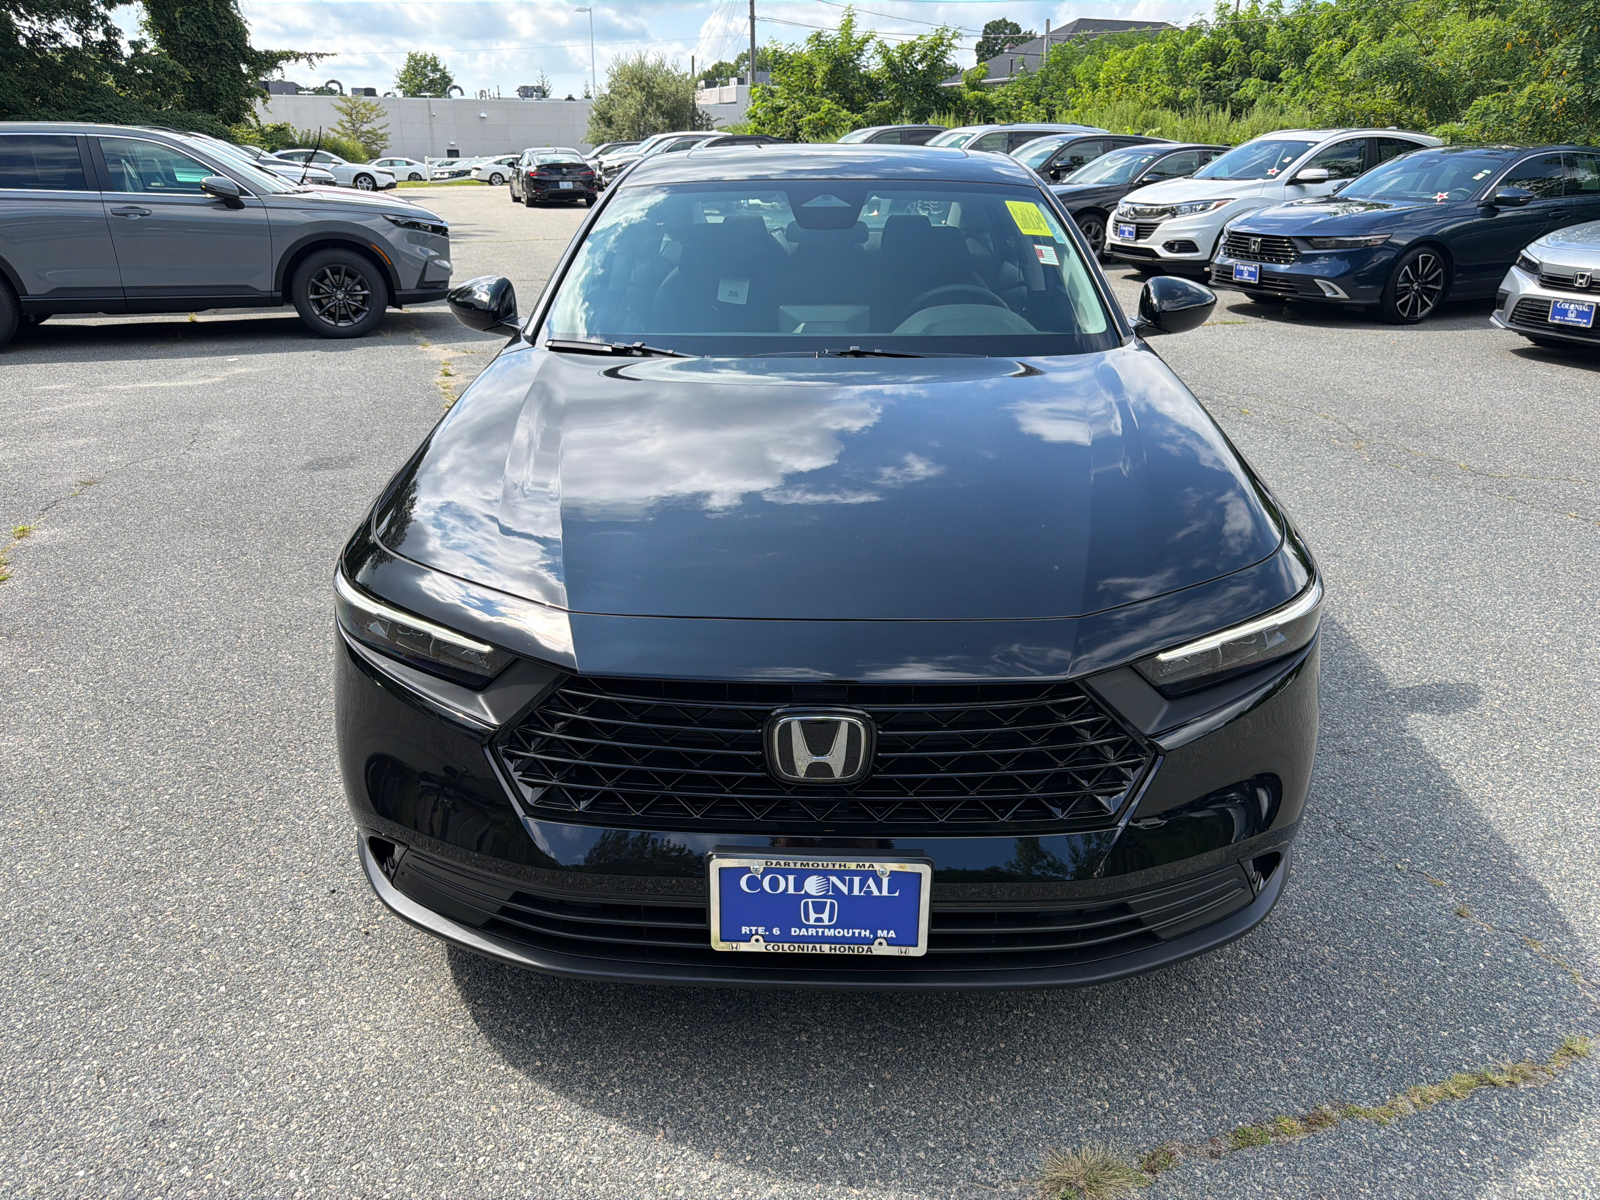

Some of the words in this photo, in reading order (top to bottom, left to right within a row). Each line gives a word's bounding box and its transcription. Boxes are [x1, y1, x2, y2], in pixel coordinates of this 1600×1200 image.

[739, 873, 899, 897] COLONIAL
[741, 926, 769, 936] RTE.
[772, 927, 781, 936] 6
[790, 927, 874, 939] DARTMOUTH,
[877, 929, 896, 939] MA
[764, 943, 828, 953] COLONIAL
[829, 944, 874, 954] HONDA
